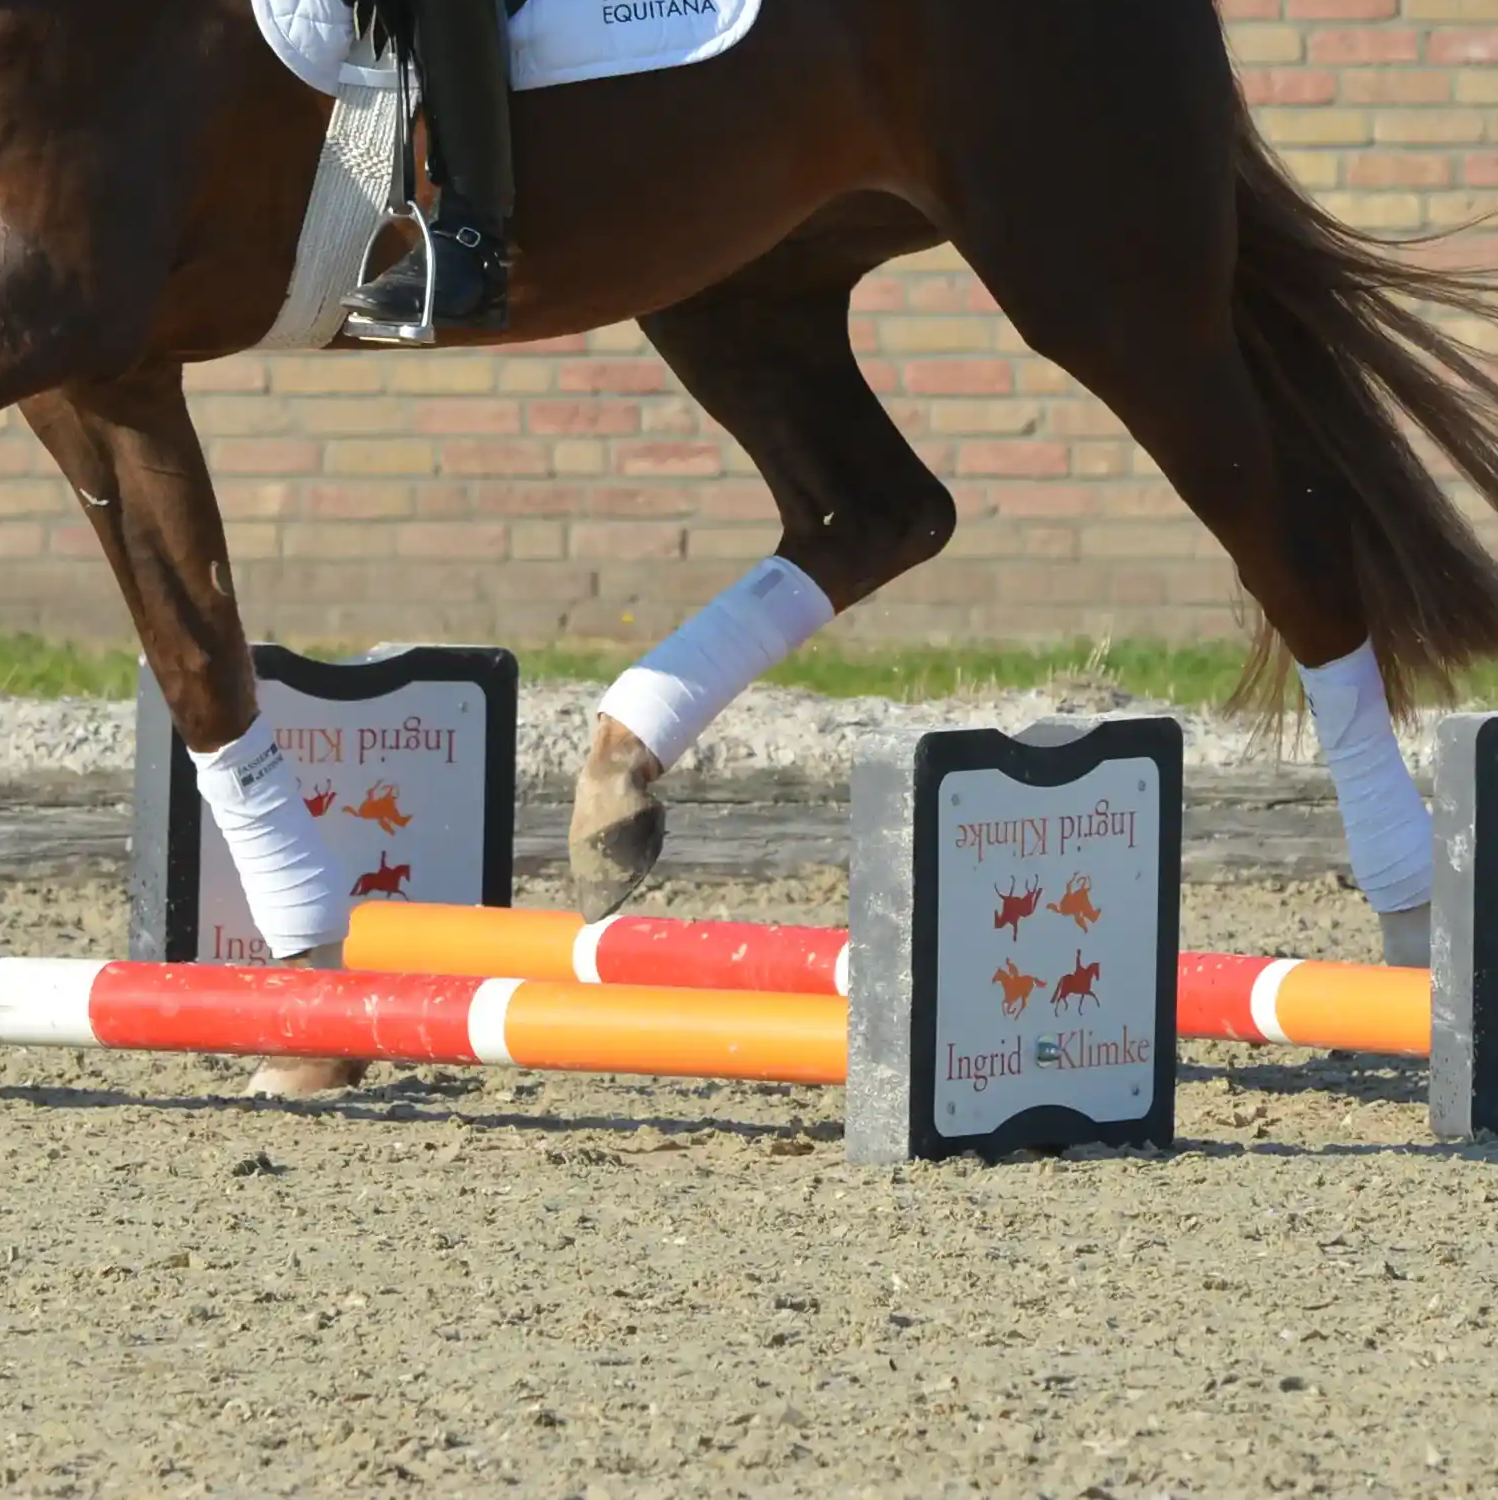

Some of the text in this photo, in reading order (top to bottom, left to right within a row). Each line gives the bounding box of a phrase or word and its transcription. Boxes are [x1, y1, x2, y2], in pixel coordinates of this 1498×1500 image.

[275, 718, 457, 764] Ingrid Klim
[955, 799, 1137, 861] Ingrid Klimke
[213, 925, 273, 966] Ing
[946, 1026, 1150, 1091] Ingrid Klimke
